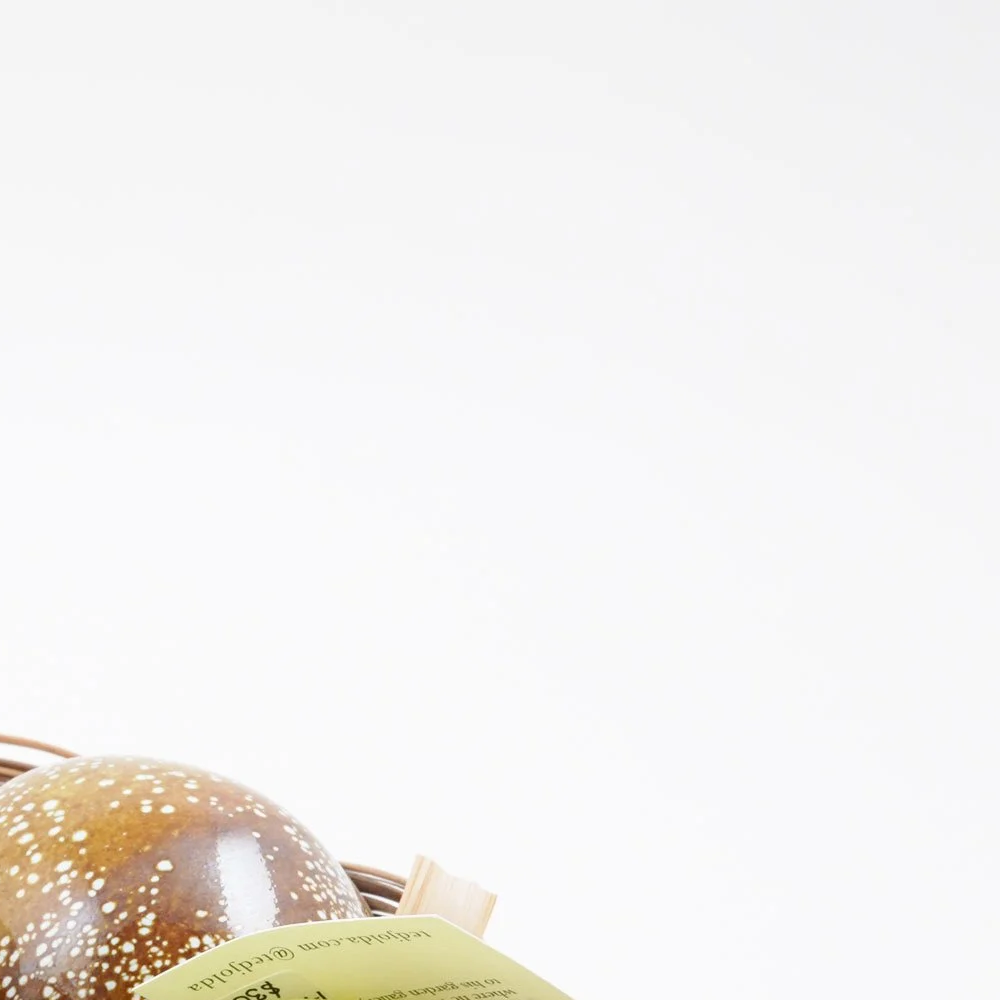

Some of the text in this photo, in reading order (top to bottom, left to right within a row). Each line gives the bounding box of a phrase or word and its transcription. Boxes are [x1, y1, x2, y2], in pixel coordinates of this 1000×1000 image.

[187, 929, 432, 993] tedjolda.com @tedjolda
[484, 978, 502, 986] to
[407, 981, 460, 998] garden
[472, 988, 517, 1000] where
